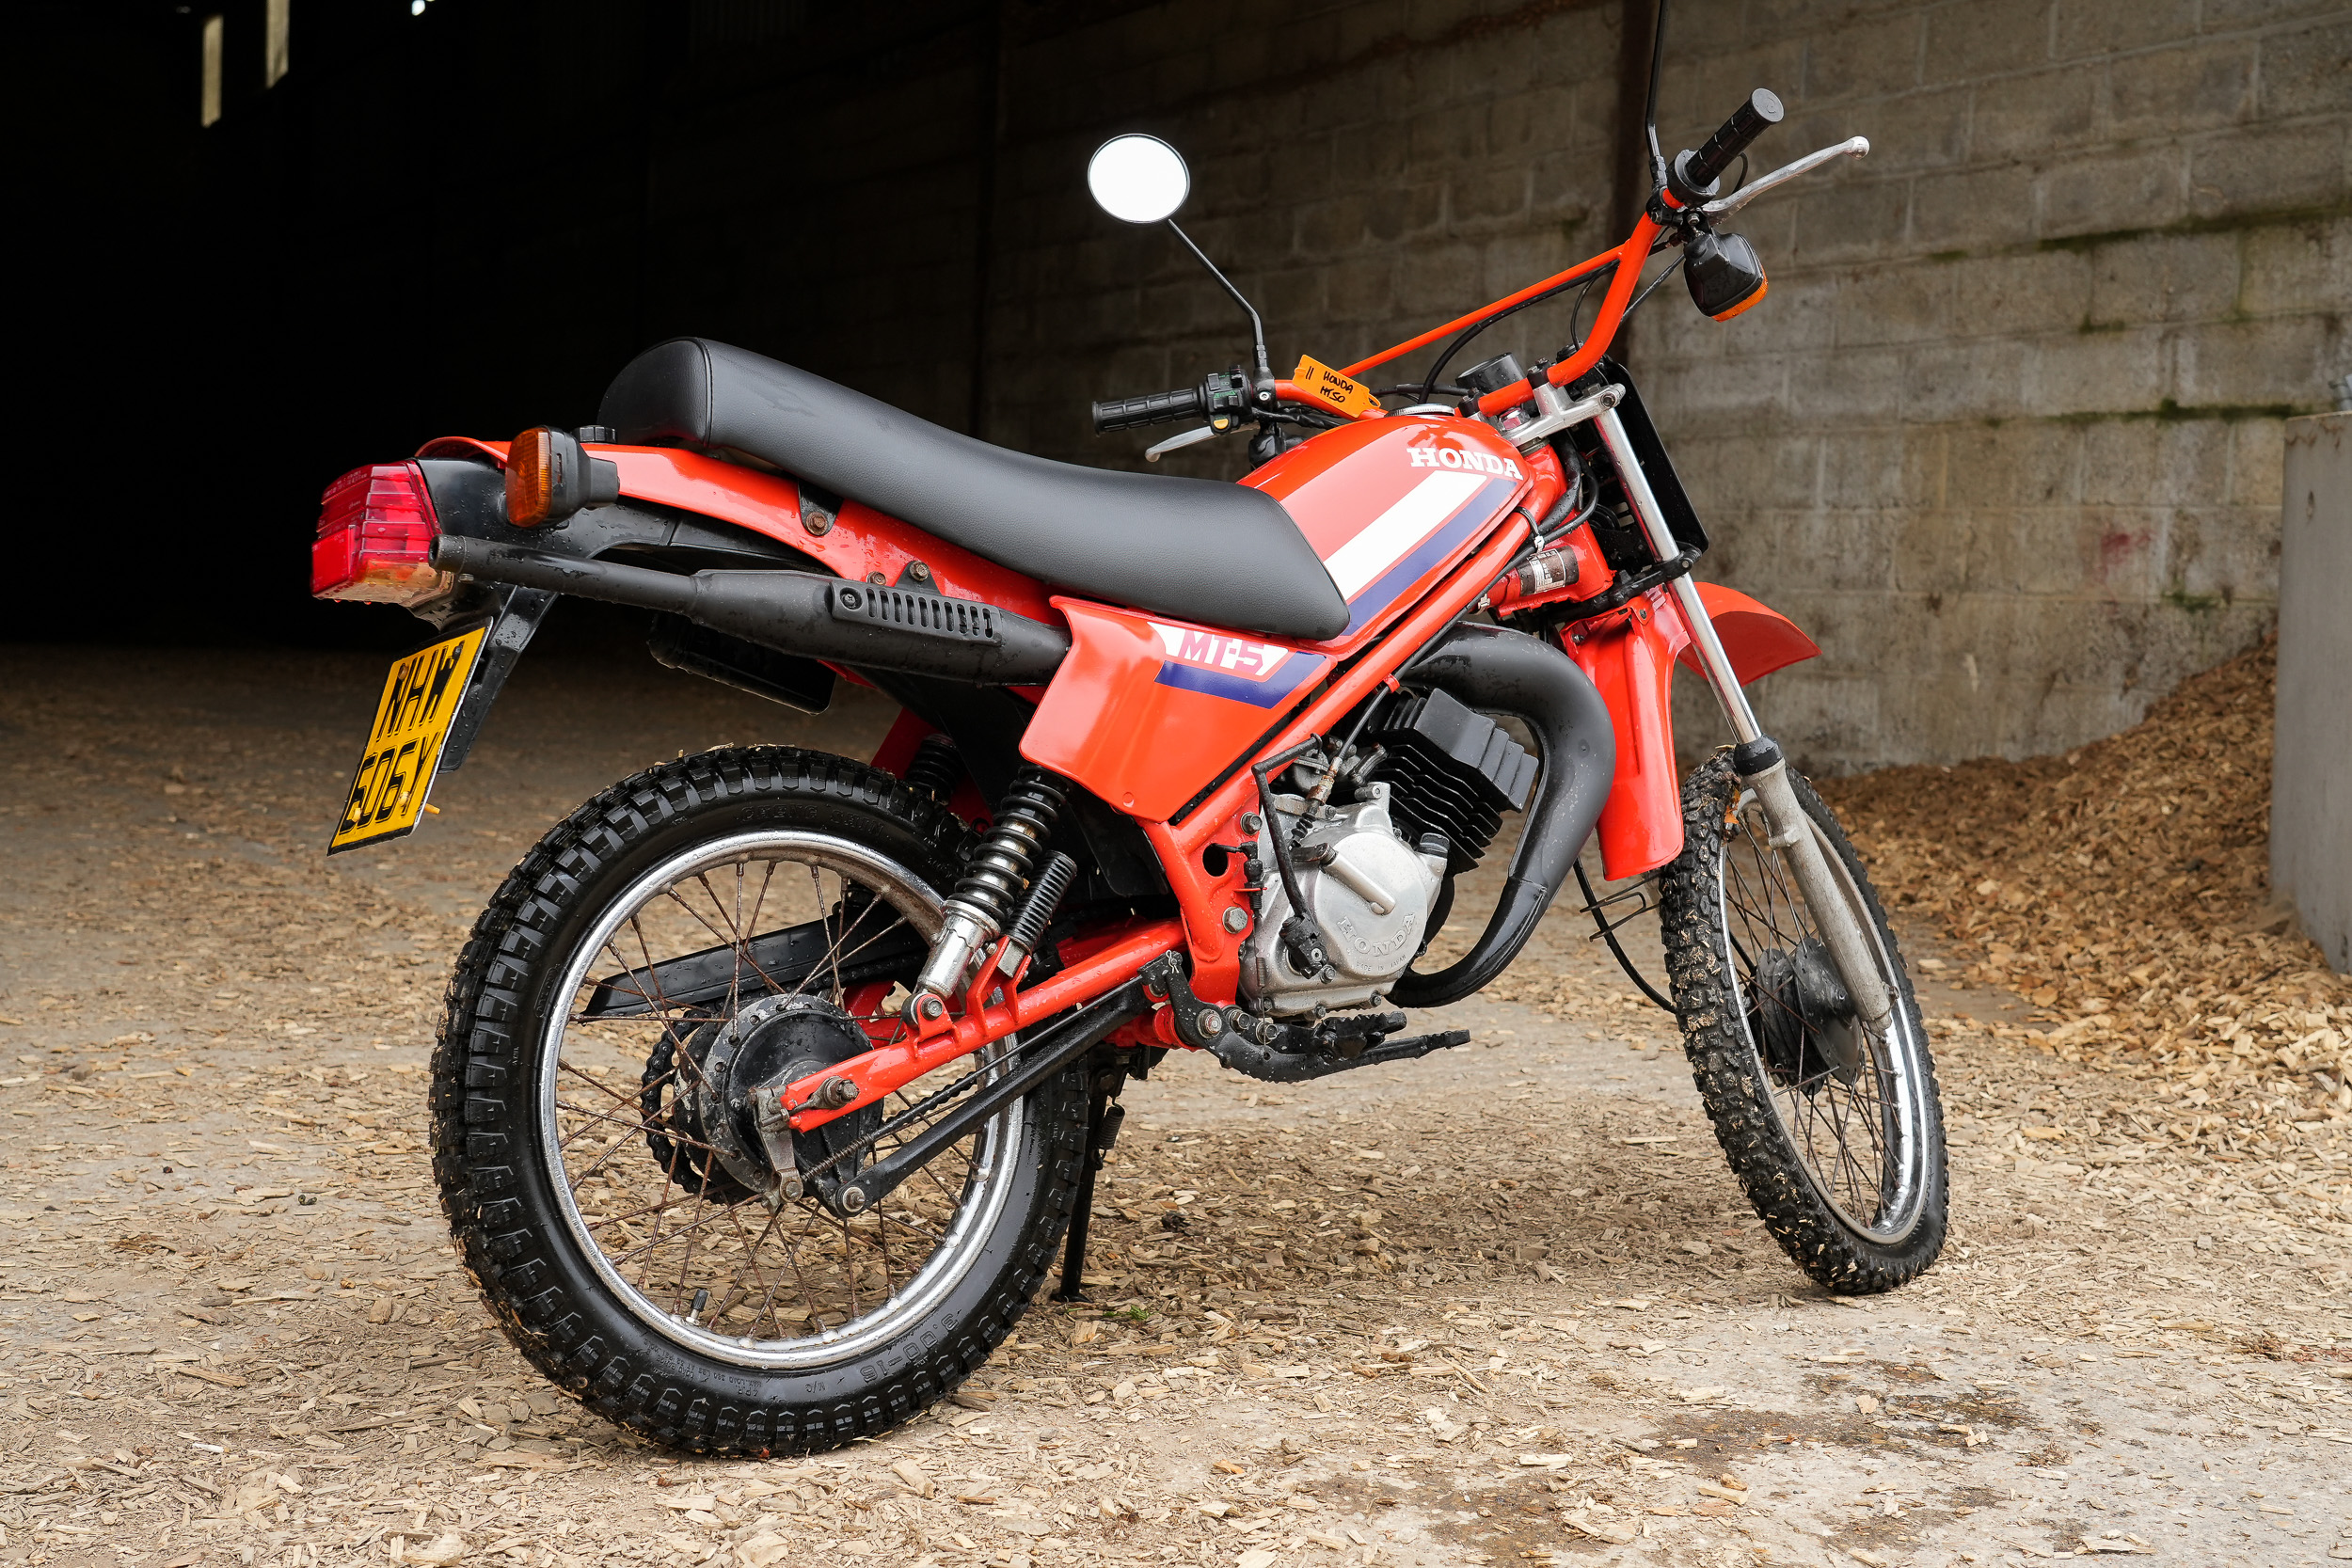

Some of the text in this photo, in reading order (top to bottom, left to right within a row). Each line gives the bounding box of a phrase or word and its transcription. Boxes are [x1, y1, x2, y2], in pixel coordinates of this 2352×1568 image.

[1323, 371, 1354, 394] HONDA
[1406, 448, 1524, 481] HONDA
[1177, 629, 1264, 674] MT-5
[376, 640, 465, 743] NHW
[339, 730, 441, 835] 506Y
[740, 804, 885, 837] CHENG SHIN
[1337, 912, 1415, 957] HONDA
[1357, 961, 1372, 972] MADE
[1391, 954, 1406, 968] JAPAN
